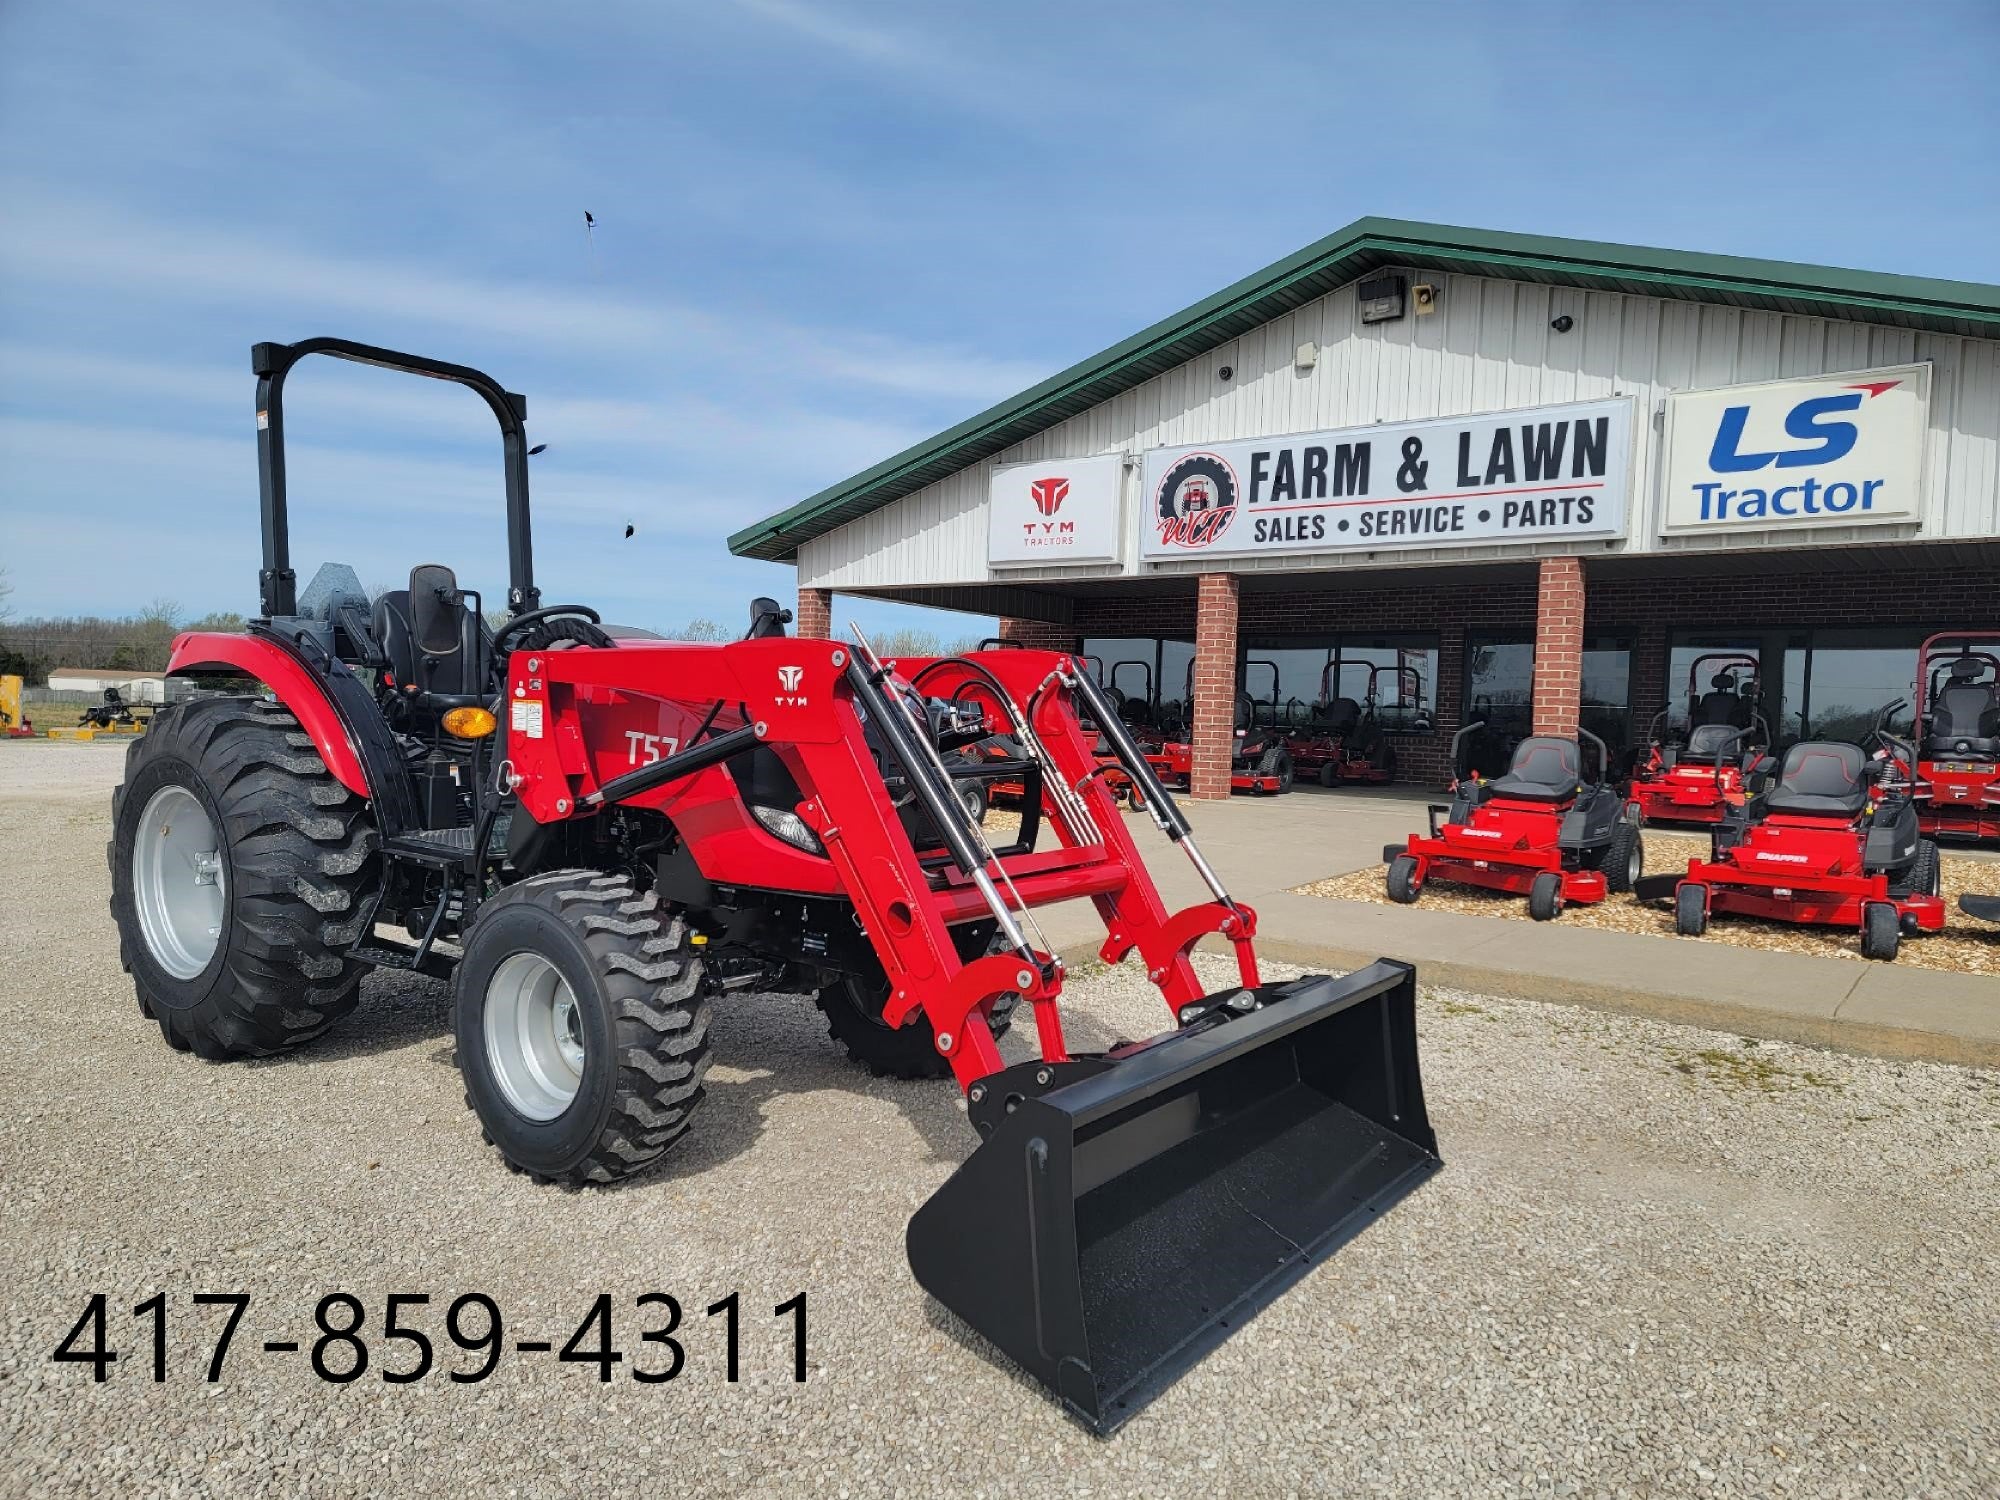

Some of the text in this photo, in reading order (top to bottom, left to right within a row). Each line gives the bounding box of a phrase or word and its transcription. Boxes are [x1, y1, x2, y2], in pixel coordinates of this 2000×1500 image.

[1708, 393, 1862, 473] LS
[1248, 416, 1610, 503] FARM & LAWN
[1691, 477, 1884, 520] Tractor
[1023, 522, 1074, 536] TYM
[1254, 496, 1594, 543] SALES SERVICE PARTS
[1023, 536, 1074, 547] TRACTORS
[774, 697, 808, 706] TYM
[624, 730, 692, 767] T57
